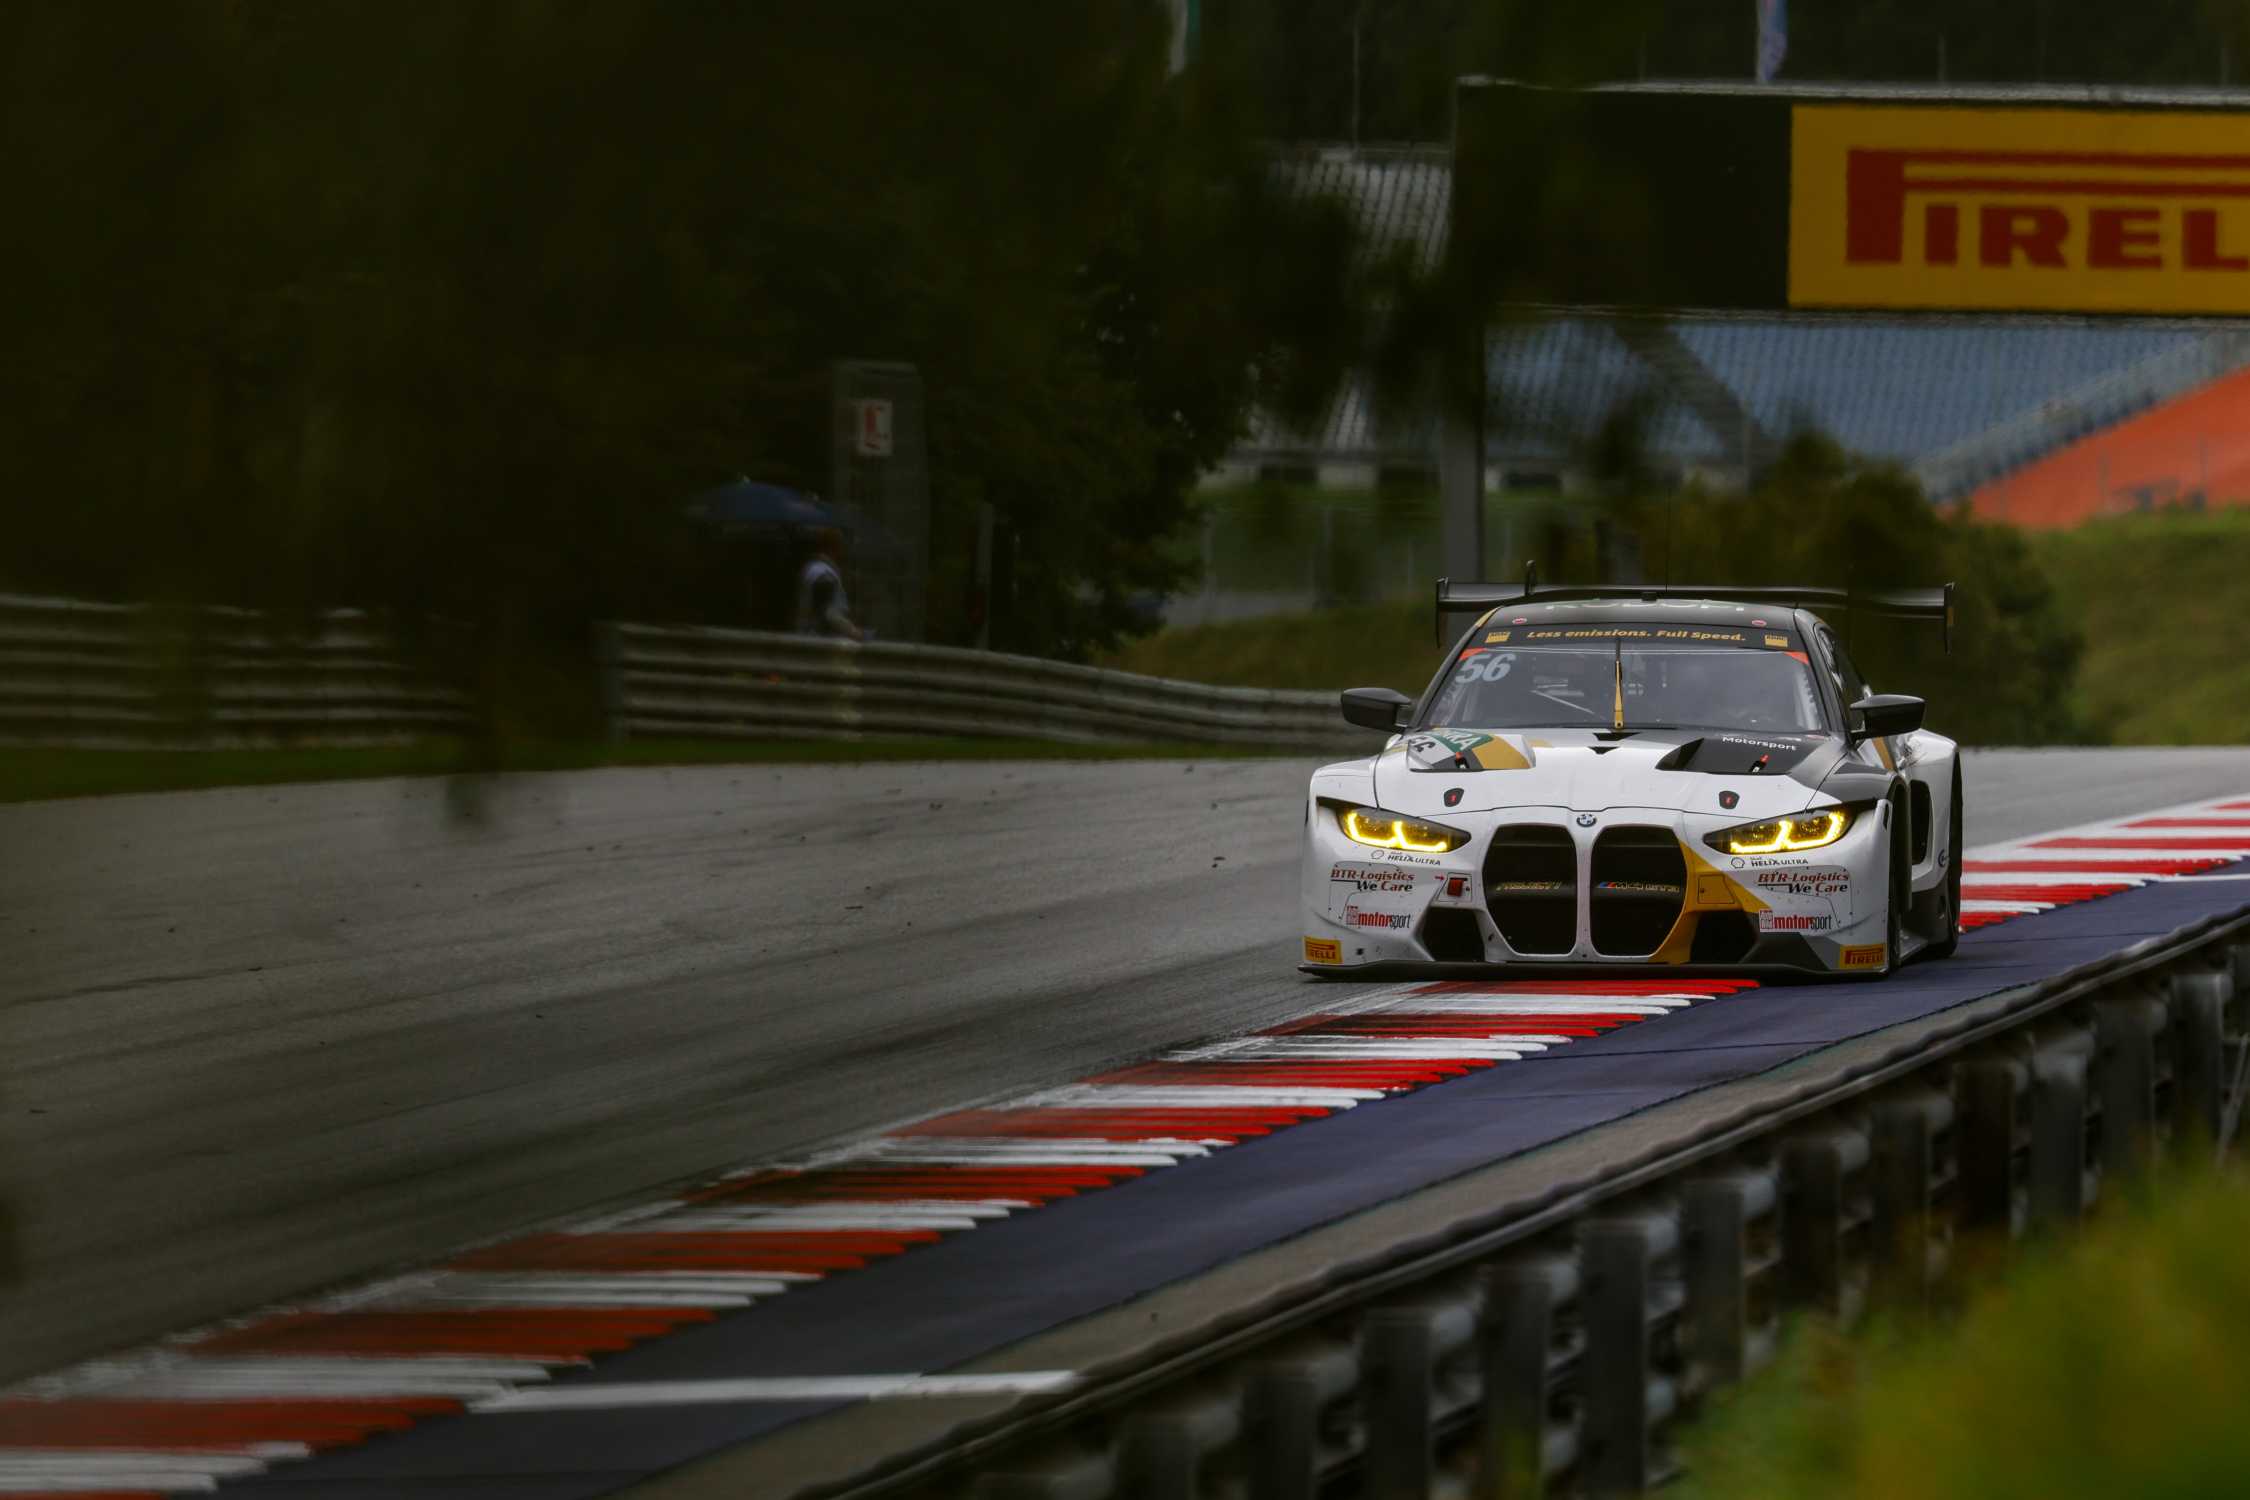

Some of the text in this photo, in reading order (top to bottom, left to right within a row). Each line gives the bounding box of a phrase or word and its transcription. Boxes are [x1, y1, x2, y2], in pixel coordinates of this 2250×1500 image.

[1526, 628, 1746, 641] Less emissions. Full Speed.
[1454, 652, 1517, 683] 56
[1722, 736, 1797, 751] Motorsport
[1387, 854, 1441, 865] HELIX ULTRA
[1751, 858, 1779, 867] HELIX
[1781, 858, 1809, 866] ULTRA
[1330, 868, 1416, 881] BTR-Logistics
[1758, 871, 1849, 884] BTR-Logistics
[1356, 880, 1413, 891] We Care
[1788, 883, 1848, 893] We Care
[1359, 912, 1412, 929] motorsport
[1773, 915, 1832, 931] motorsport
